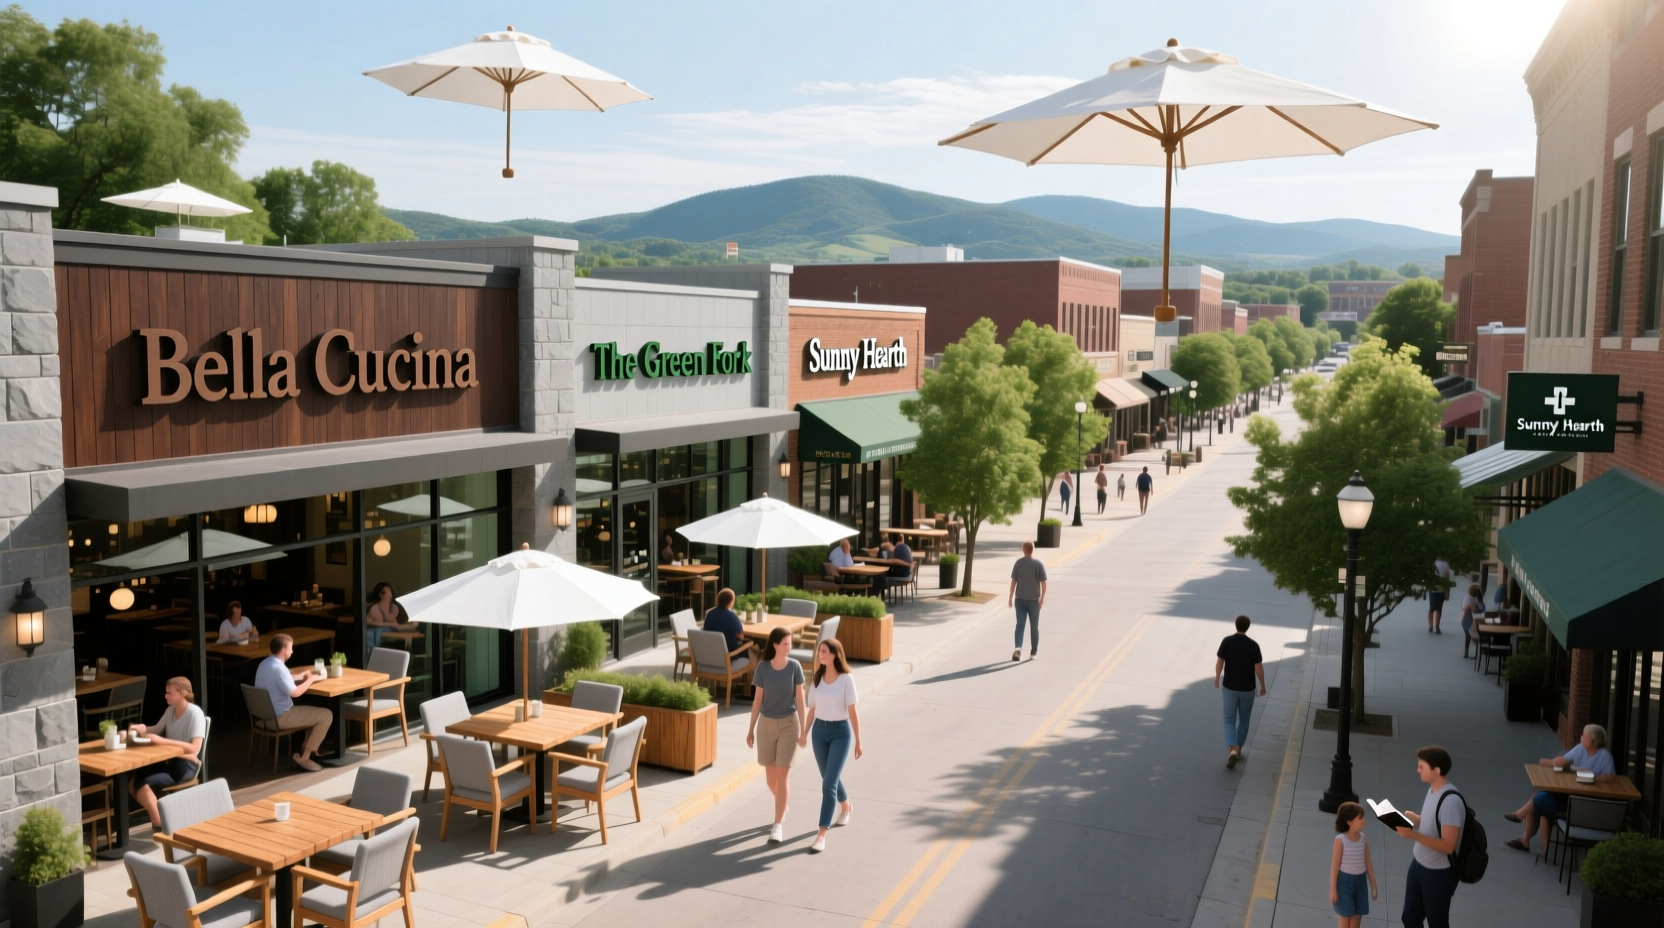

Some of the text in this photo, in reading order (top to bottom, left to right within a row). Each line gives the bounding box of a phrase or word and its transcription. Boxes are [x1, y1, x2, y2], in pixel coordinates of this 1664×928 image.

[138, 327, 480, 405] Bella Cucina
[590, 340, 753, 381] The Green Fork
[809, 336, 908, 381] Sunny Hearth
[1516, 417, 1559, 436] Sunny
[1562, 418, 1605, 432] Hearth
